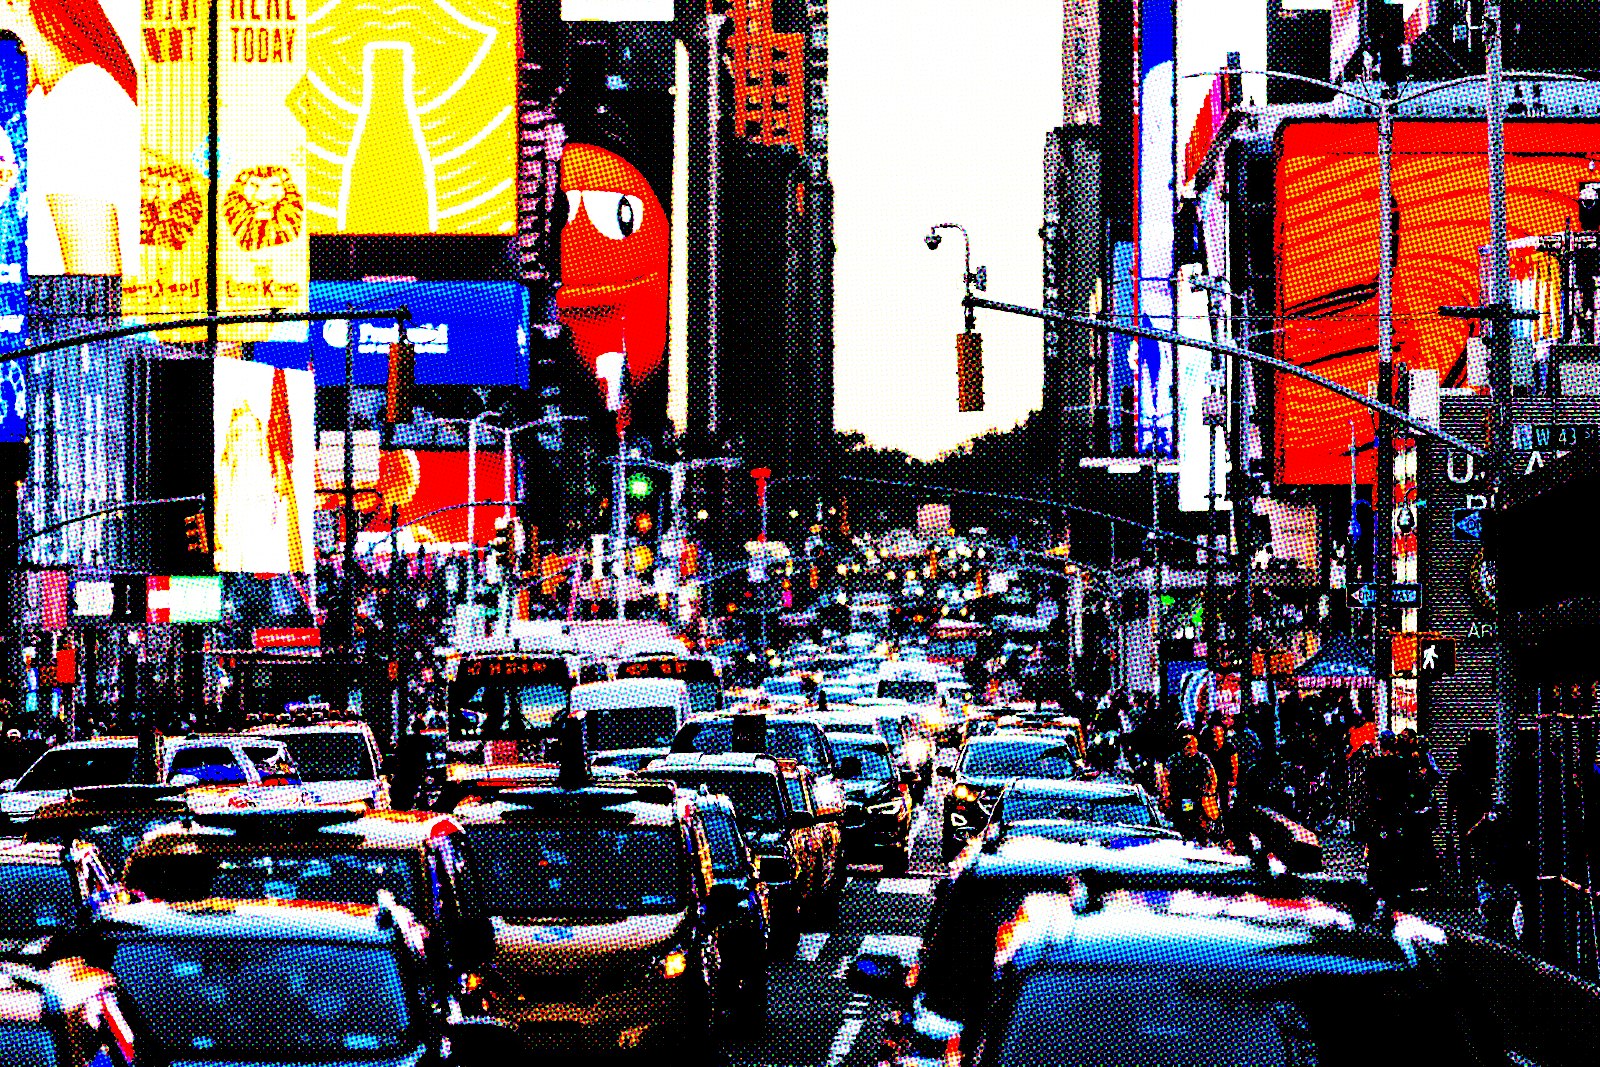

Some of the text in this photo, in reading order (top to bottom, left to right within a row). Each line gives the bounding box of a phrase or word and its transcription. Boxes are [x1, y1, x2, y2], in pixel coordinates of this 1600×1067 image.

[230, 27, 295, 62] TODAY
[1535, 428, 1550, 445] W
[1558, 428, 1577, 446] 43
